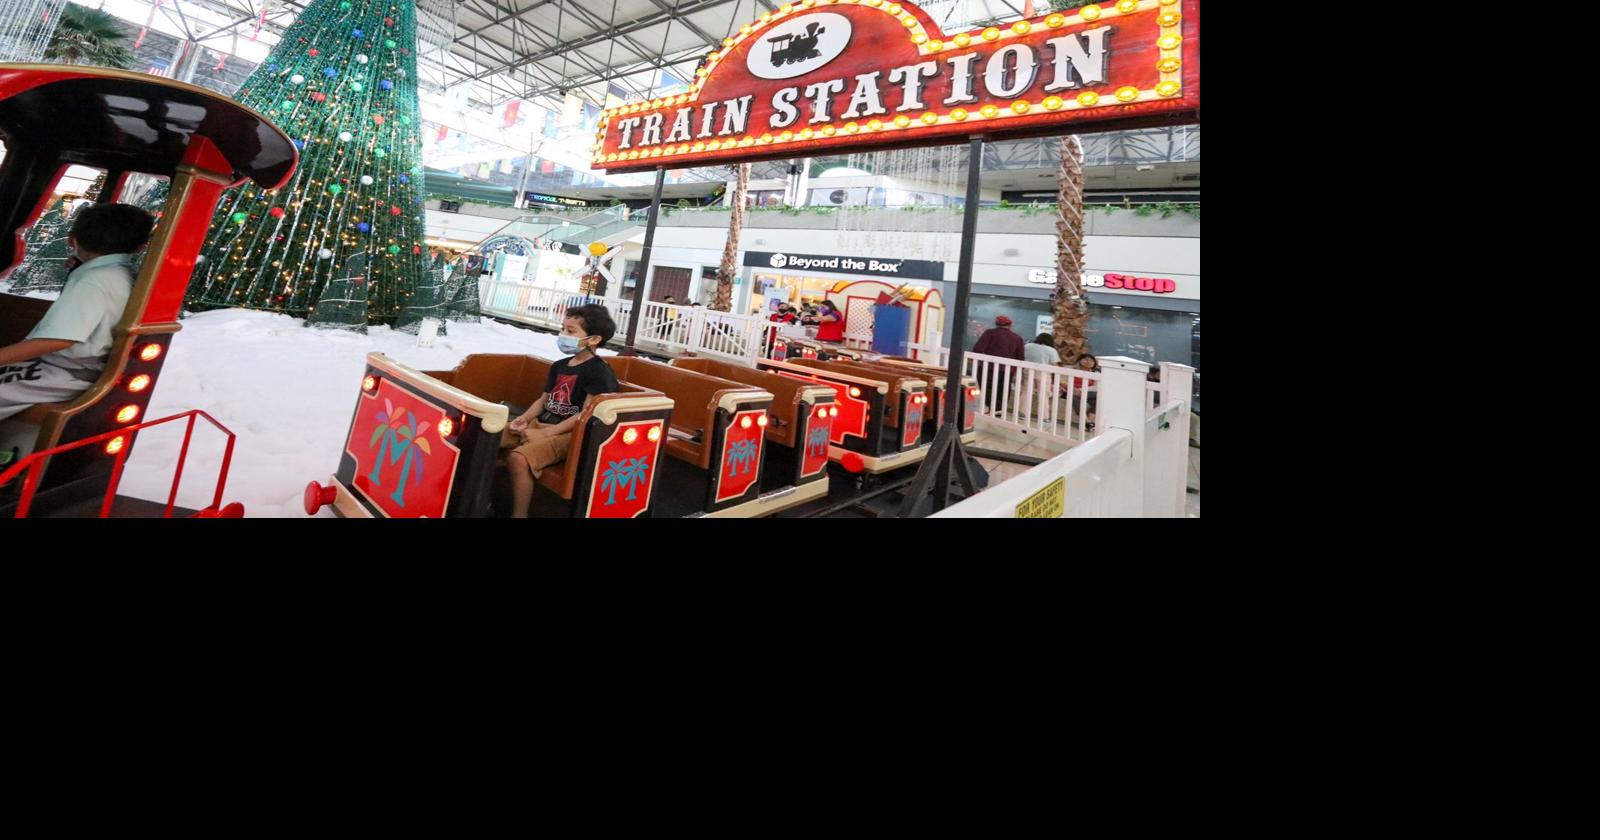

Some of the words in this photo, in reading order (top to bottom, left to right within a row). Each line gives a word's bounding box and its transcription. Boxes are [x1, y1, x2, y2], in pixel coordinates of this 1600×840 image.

[618, 95, 753, 150] TRAIN
[769, 25, 1114, 129] STATION
[789, 255, 838, 269] Beyond
[841, 257, 866, 270] the
[868, 260, 899, 273] Box
[1031, 491, 1046, 511] YOUR
